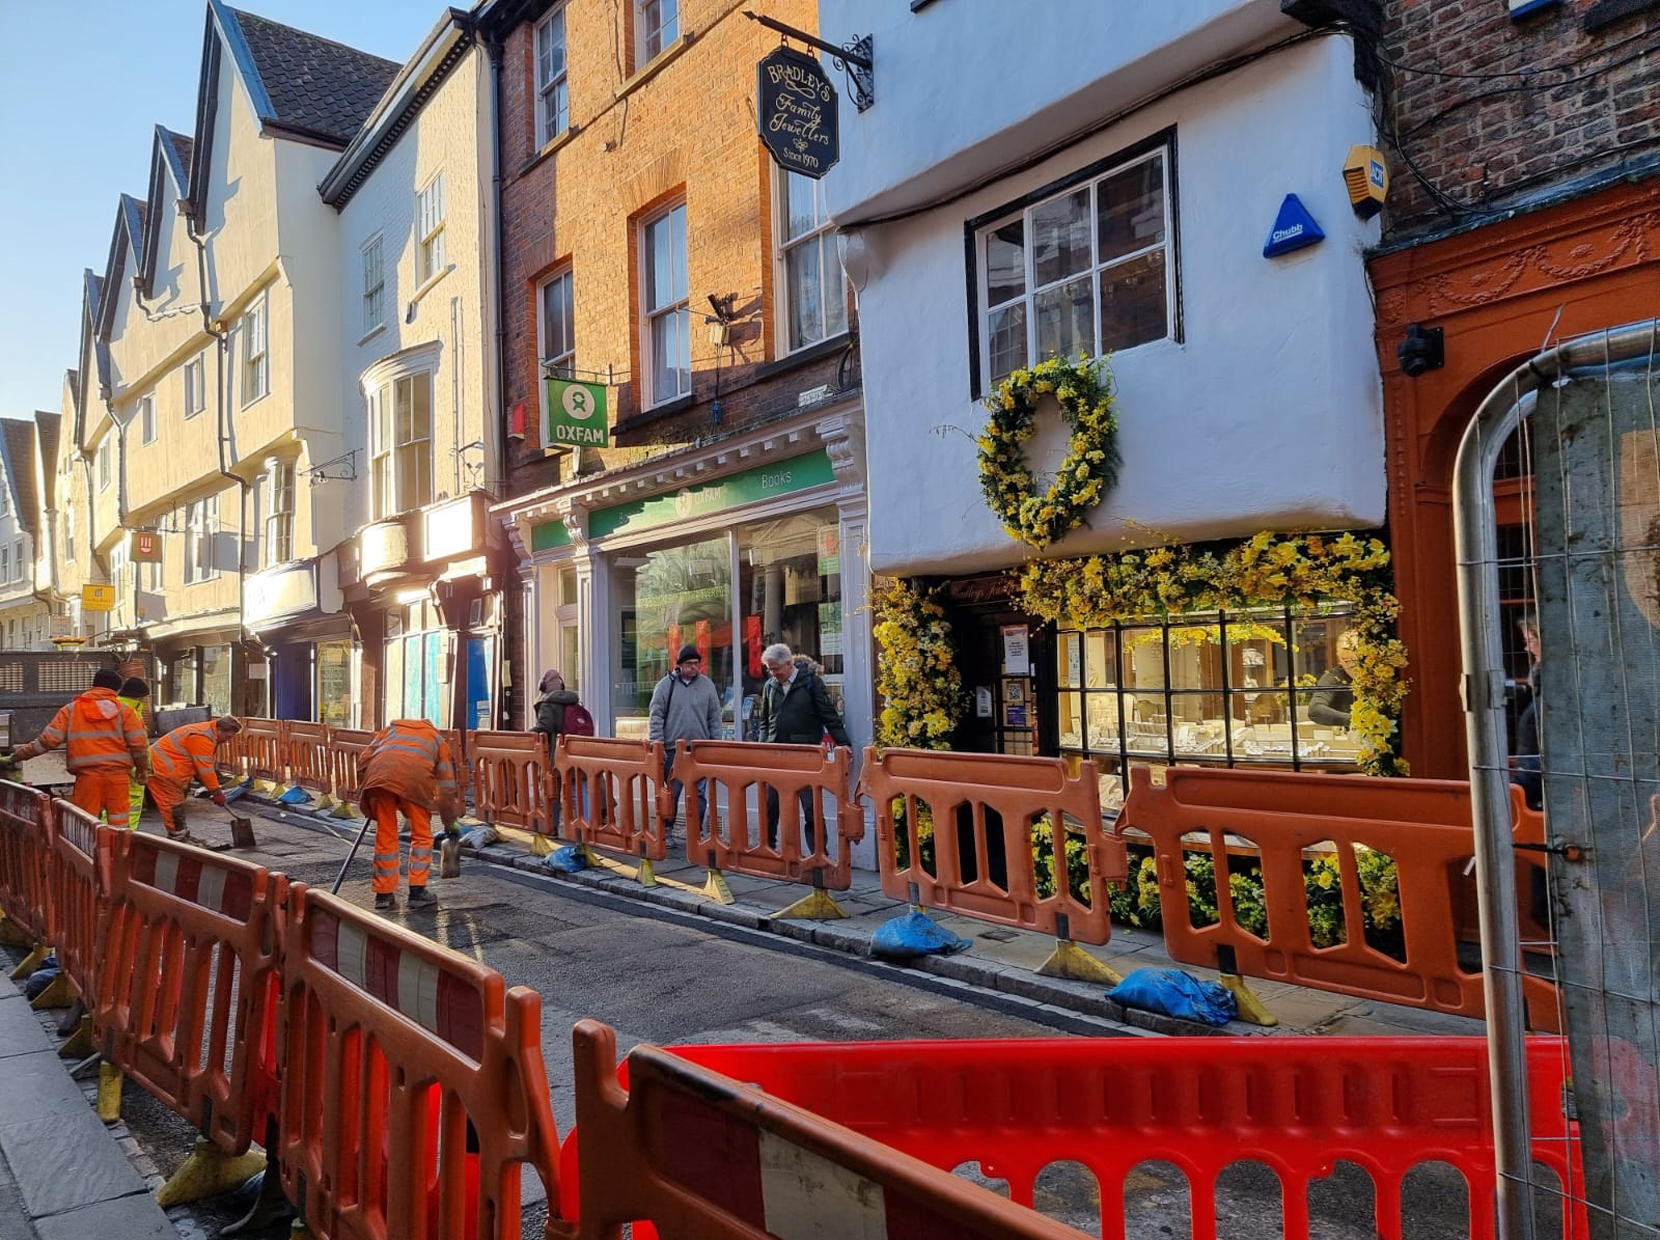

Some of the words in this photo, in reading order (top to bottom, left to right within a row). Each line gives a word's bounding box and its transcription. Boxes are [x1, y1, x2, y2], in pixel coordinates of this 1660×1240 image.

[775, 93, 822, 127] Family
[769, 113, 829, 145] Jewellers
[783, 147, 802, 162] Since
[802, 153, 819, 168] 1970
[1370, 163, 1383, 184] ADT
[1272, 223, 1303, 241] Chubb
[556, 424, 604, 444] OXFAM
